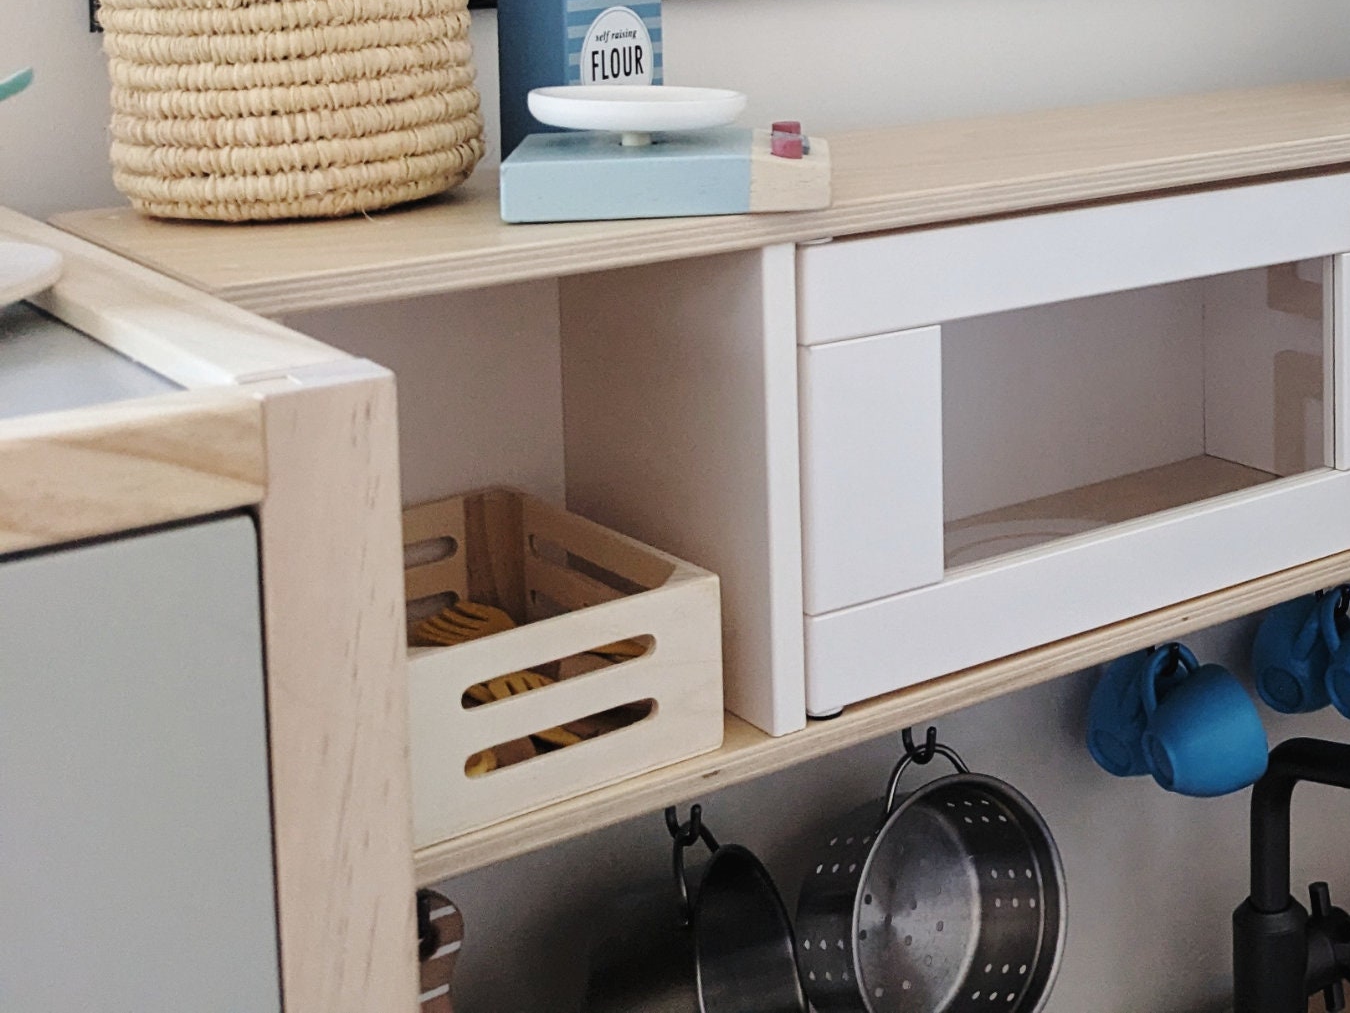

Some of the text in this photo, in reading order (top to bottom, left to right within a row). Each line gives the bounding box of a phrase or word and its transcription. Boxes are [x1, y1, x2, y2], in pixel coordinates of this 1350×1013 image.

[595, 28, 637, 43] self raising
[591, 44, 644, 82] FLOUR
